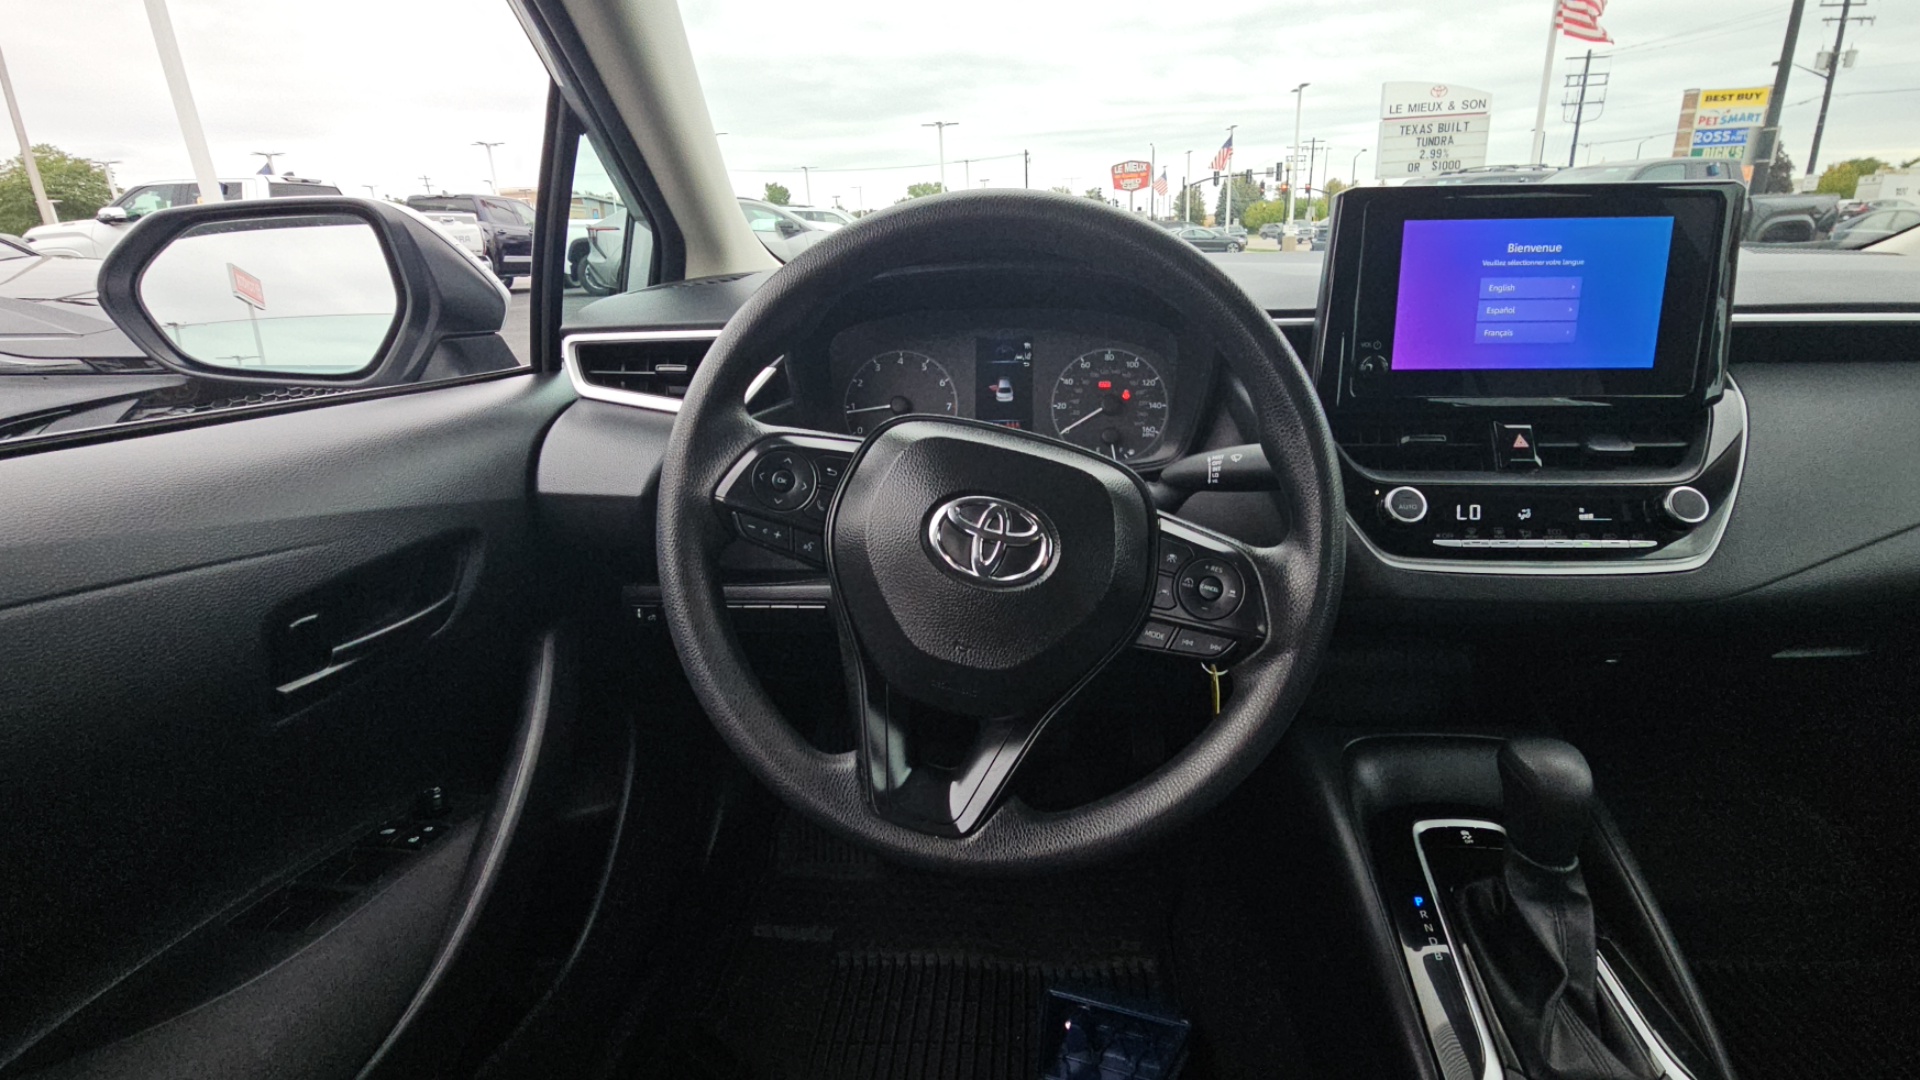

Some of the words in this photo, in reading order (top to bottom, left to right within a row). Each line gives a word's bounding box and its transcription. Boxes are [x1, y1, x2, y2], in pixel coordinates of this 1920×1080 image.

[1705, 94, 1735, 102] BEST
[1736, 92, 1762, 100] BUY
[1389, 104, 1402, 114] LE
[1407, 101, 1443, 113] MIEUX
[1447, 101, 1455, 111] &
[1461, 99, 1487, 110] SON
[1400, 123, 1433, 135] TEXAS
[1437, 121, 1470, 133] BUILT
[1416, 135, 1454, 148] TUNDRA
[1694, 130, 1732, 143] ROSS
[1419, 149, 1450, 160] 2.99%
[1114, 165, 1123, 174] LE
[1124, 162, 1147, 173] MIEUX
[1407, 162, 1421, 173] OR
[1507, 243, 1563, 253] Bienvenue
[1562, 258, 1585, 267] langue
[1488, 284, 1515, 293] English
[1486, 307, 1515, 316] Español
[1484, 329, 1513, 339] Français
[897, 357, 904, 365] 4
[1104, 353, 1115, 361] 80
[875, 363, 881, 372] 3
[921, 362, 928, 371] 5
[857, 379, 863, 387] 2
[939, 379, 946, 387] 6
[946, 402, 952, 411] 7
[857, 426, 863, 434] 0
[1456, 504, 1481, 521] LO
[1210, 565, 1224, 574] RES
[1200, 583, 1219, 593] CANCEL
[1144, 630, 1165, 641] MODE
[1414, 896, 1423, 907] P
[1419, 910, 1429, 919] R
[1423, 923, 1434, 932] N
[1428, 936, 1438, 946] D
